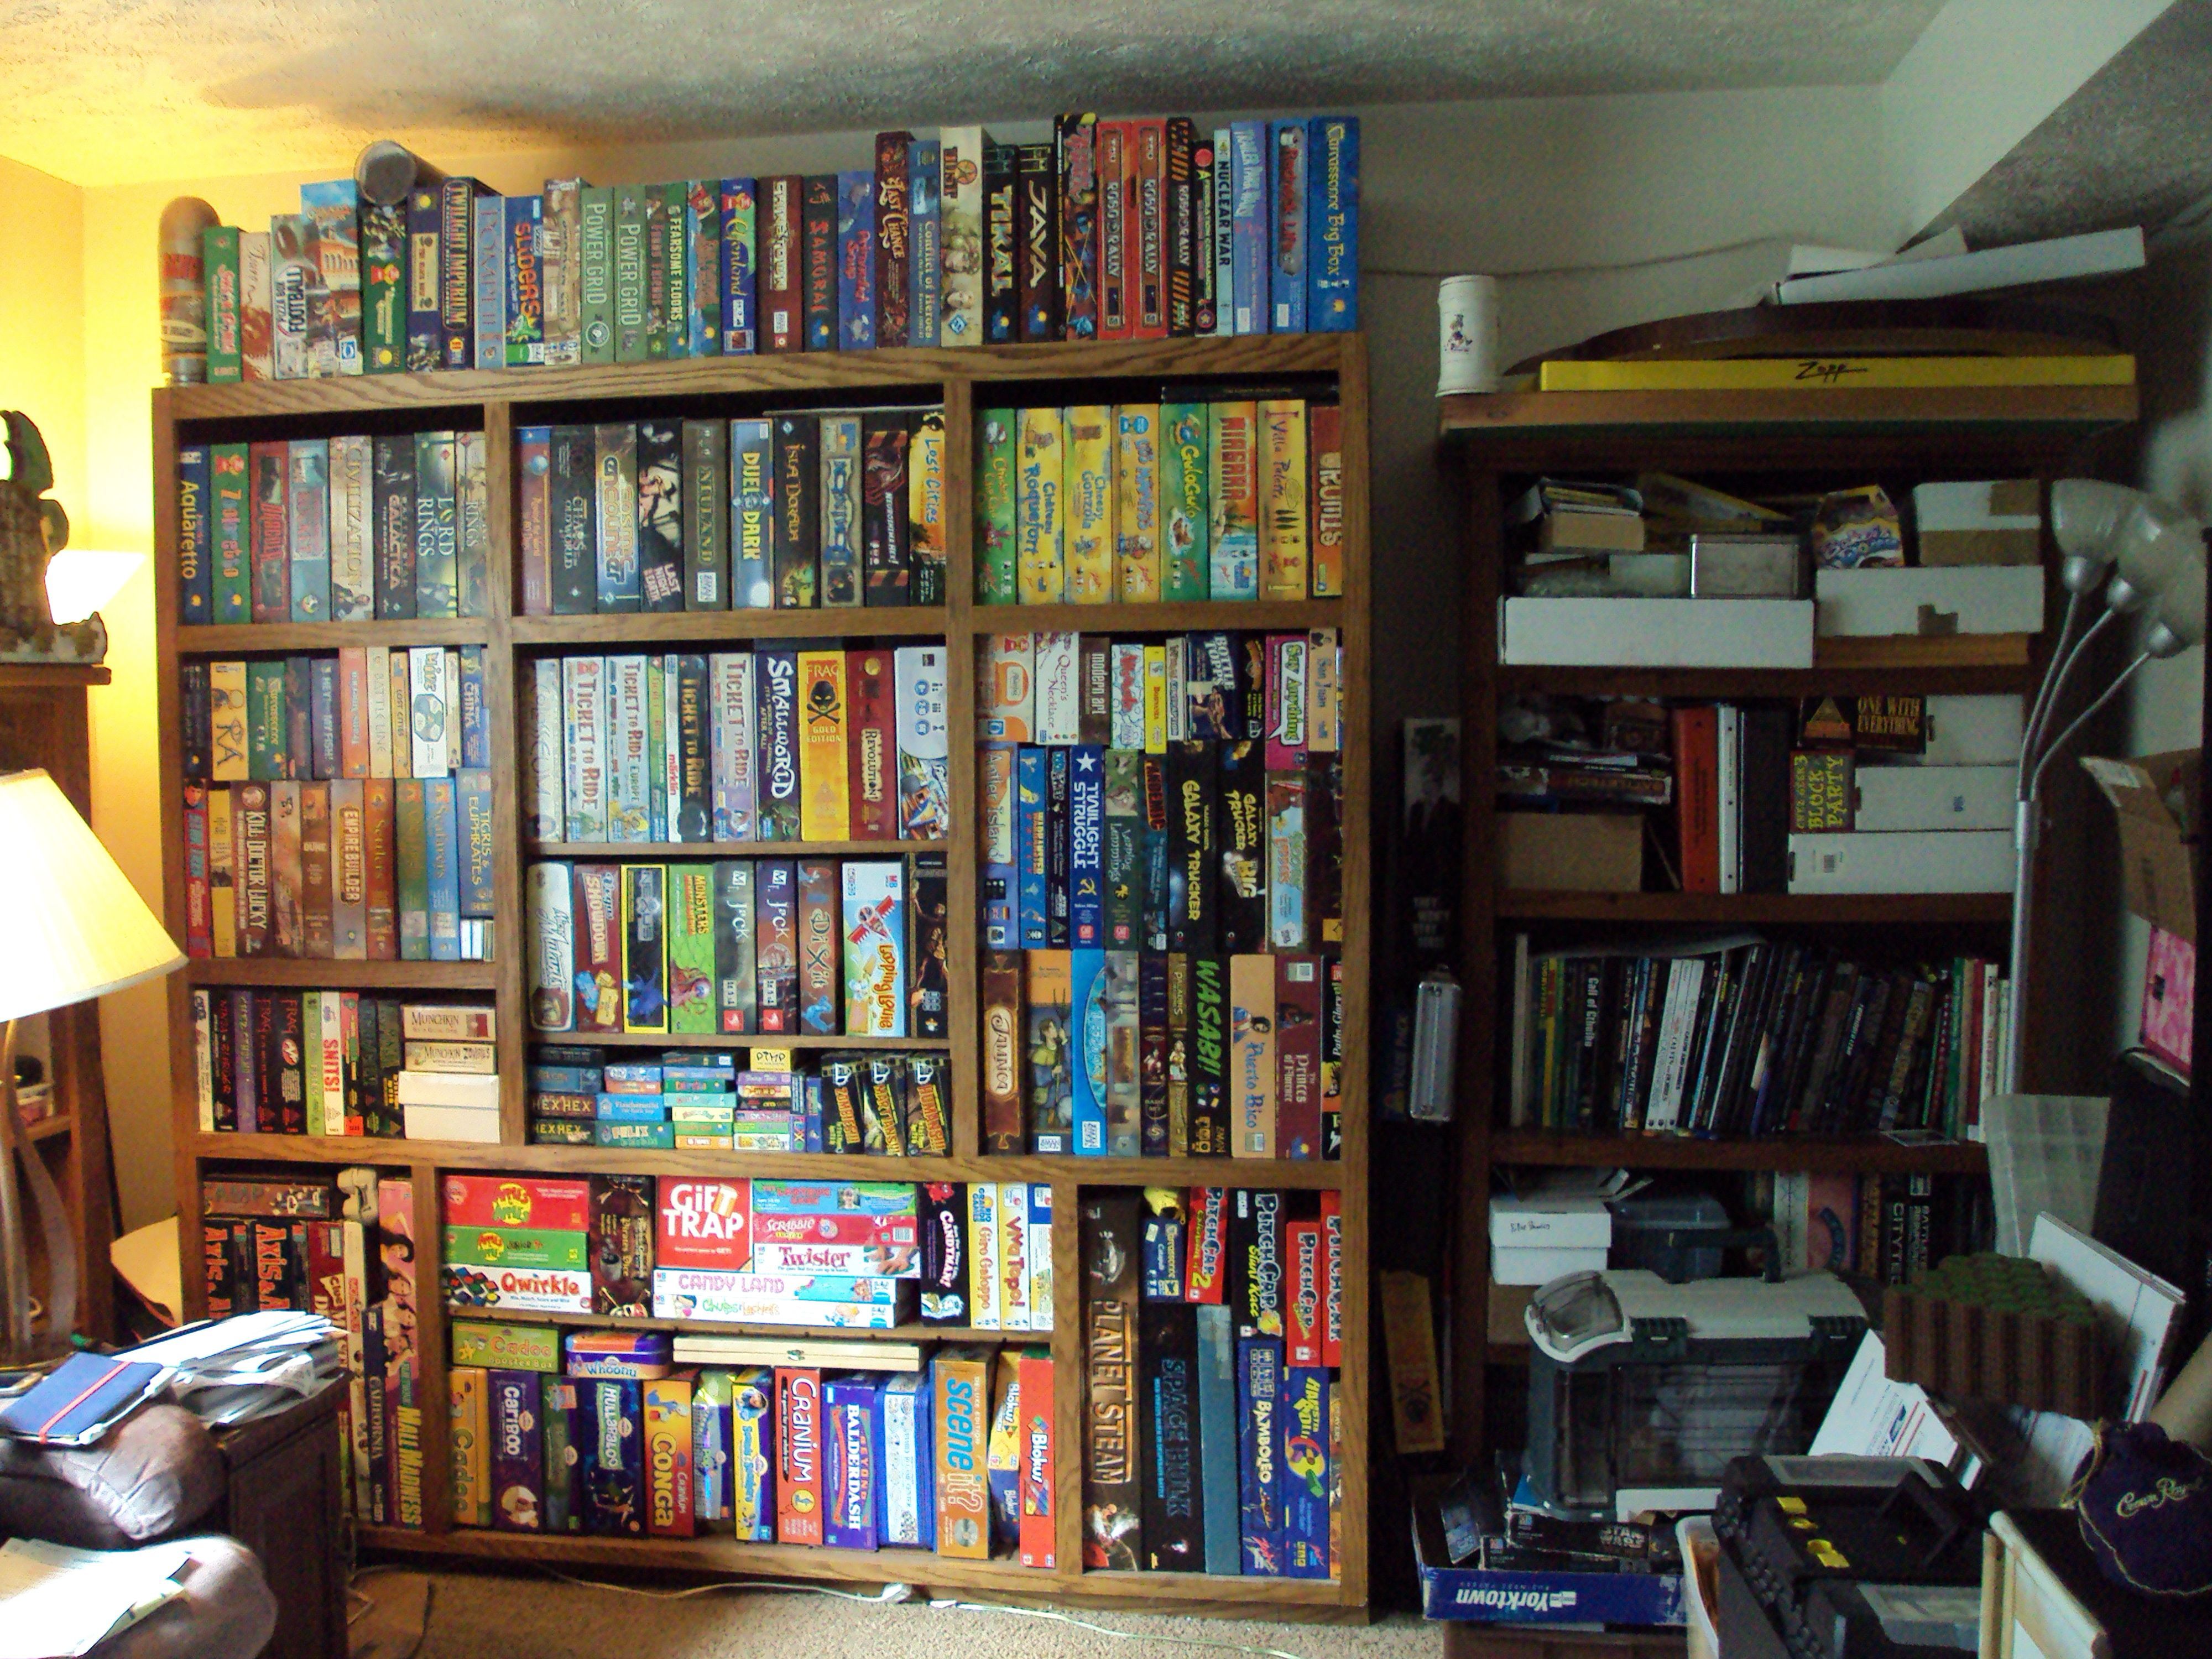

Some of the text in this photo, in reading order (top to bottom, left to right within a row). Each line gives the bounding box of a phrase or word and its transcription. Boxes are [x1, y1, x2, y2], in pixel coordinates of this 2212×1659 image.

[1029, 180, 1046, 288] JAVA
[1218, 161, 1230, 265] NUCLEAR WAR
[1324, 123, 1345, 275] Carcassonne Big Box
[450, 186, 468, 324] TWILIGHT IMPERIUM
[479, 209, 499, 325] POMPEII
[586, 204, 607, 304] POWER GRID
[619, 224, 643, 325] POWER GRID
[670, 217, 683, 321] FEARSOME FLOORS
[725, 218, 747, 296] Elfenland
[808, 221, 829, 313] SAMURAI
[845, 240, 858, 280] Soup
[854, 230, 870, 302] Primordial
[990, 185, 1013, 296] TIKAL
[288, 271, 305, 333] FOOTBALL
[925, 221, 934, 338] Conflict of Heroes
[785, 445, 805, 542] ISLA DORADA
[925, 438, 942, 524] Lost Cities
[1220, 417, 1249, 500] NIAGARA
[180, 481, 200, 579] Aquaretto
[259, 503, 284, 562] DRACULA
[345, 445, 363, 589] CIVILIZATION
[418, 498, 435, 557] RINGS
[437, 497, 455, 556] LORD
[465, 501, 479, 548] RINGS
[571, 497, 584, 550] CHAOS
[743, 452, 760, 560] DUEL DARK
[1016, 463, 1043, 555] Roquefort
[1081, 470, 1095, 529] Gonzola
[1093, 476, 1105, 520] Cheesy
[1319, 466, 1343, 546] RUMIS
[389, 494, 401, 589] GALACTICA
[805, 665, 839, 684] FRAG
[1092, 653, 1106, 715] modern art
[1214, 636, 1235, 690] BOTTLE
[1284, 644, 1302, 741] Say Anything
[374, 672, 387, 753] BATTLE LINE
[464, 681, 474, 729] CHINA
[624, 662, 644, 802] TICKET TO RIDE EUROPE
[681, 677, 703, 798] TICKET TO RIDE
[726, 660, 750, 788] TICKET TO RIDE
[1047, 679, 1060, 729] Necklace
[1858, 696, 1922, 717] ONE WITH
[216, 718, 246, 770] RA
[577, 679, 601, 810] TICKET TO RIDE
[668, 754, 679, 796] märklin
[865, 731, 878, 801] REVOLUTION!
[988, 753, 1005, 861] Antler Island
[1073, 781, 1086, 869] STRUGGLE
[1086, 782, 1099, 869] TWILIGHT
[1224, 790, 1245, 850] TRUCKER
[1243, 793, 1257, 848] GALAXY
[1808, 769, 1825, 830] BLOCK
[1825, 754, 1848, 828] PARTY
[246, 811, 267, 930] KILL DOCTOR LUCKY
[345, 811, 359, 900] EMPIRE BUILDER
[373, 819, 387, 879] Settlers
[468, 796, 481, 885] EUPHRATES
[1181, 780, 1201, 921] GALAXY TRUCKER
[586, 876, 606, 963] SHOWDOWN
[694, 875, 708, 935] MONSTERS
[255, 999, 272, 1033] FRAG
[279, 999, 298, 1035] FRAG
[873, 945, 898, 1030] Looping Louie
[1583, 977, 1600, 1048] Call of Cthulhu
[323, 1039, 340, 1092] SNITS!
[990, 1014, 1010, 1091] JAMAICA
[1245, 1041, 1266, 1129] Puerto Rico
[1295, 1054, 1309, 1104] Princes
[834, 1087, 860, 1144] ZOMBIES!!!
[255, 1225, 288, 1293] Axis &
[661, 1209, 744, 1240] TRAP
[779, 1246, 851, 1267] Twister
[1004, 1216, 1025, 1308] Viva Topo!
[501, 1271, 580, 1295] Qwirkle
[677, 1272, 785, 1294] CANDY LAND
[977, 1226, 994, 1310] Giro Galoppo
[1248, 1244, 1260, 1318] Stunt Race
[490, 1335, 552, 1358] Cadoo
[586, 1363, 637, 1378] Whoonu
[368, 1375, 384, 1460] CALIFORNIA
[1005, 1382, 1020, 1422] Blokus
[1092, 1301, 1132, 1484] PLANET STEAM
[397, 1405, 424, 1526] MALL MADNESS
[452, 1428, 474, 1512] Cadoo
[846, 1404, 862, 1531] BALDERDASH
[859, 1436, 868, 1503] BEYOND
[946, 1378, 983, 1512] scene it?
[1029, 1433, 1048, 1484] Blokus
[1162, 1359, 1191, 1517] SPACE HULK
[1252, 1400, 1274, 1484] BAMBOLEO
[1004, 1489, 1018, 1516] Blokus
[1599, 1532, 1647, 1550] WARS
[1601, 1524, 1633, 1536] STAR
[1455, 1588, 1550, 1613] Yorktown
